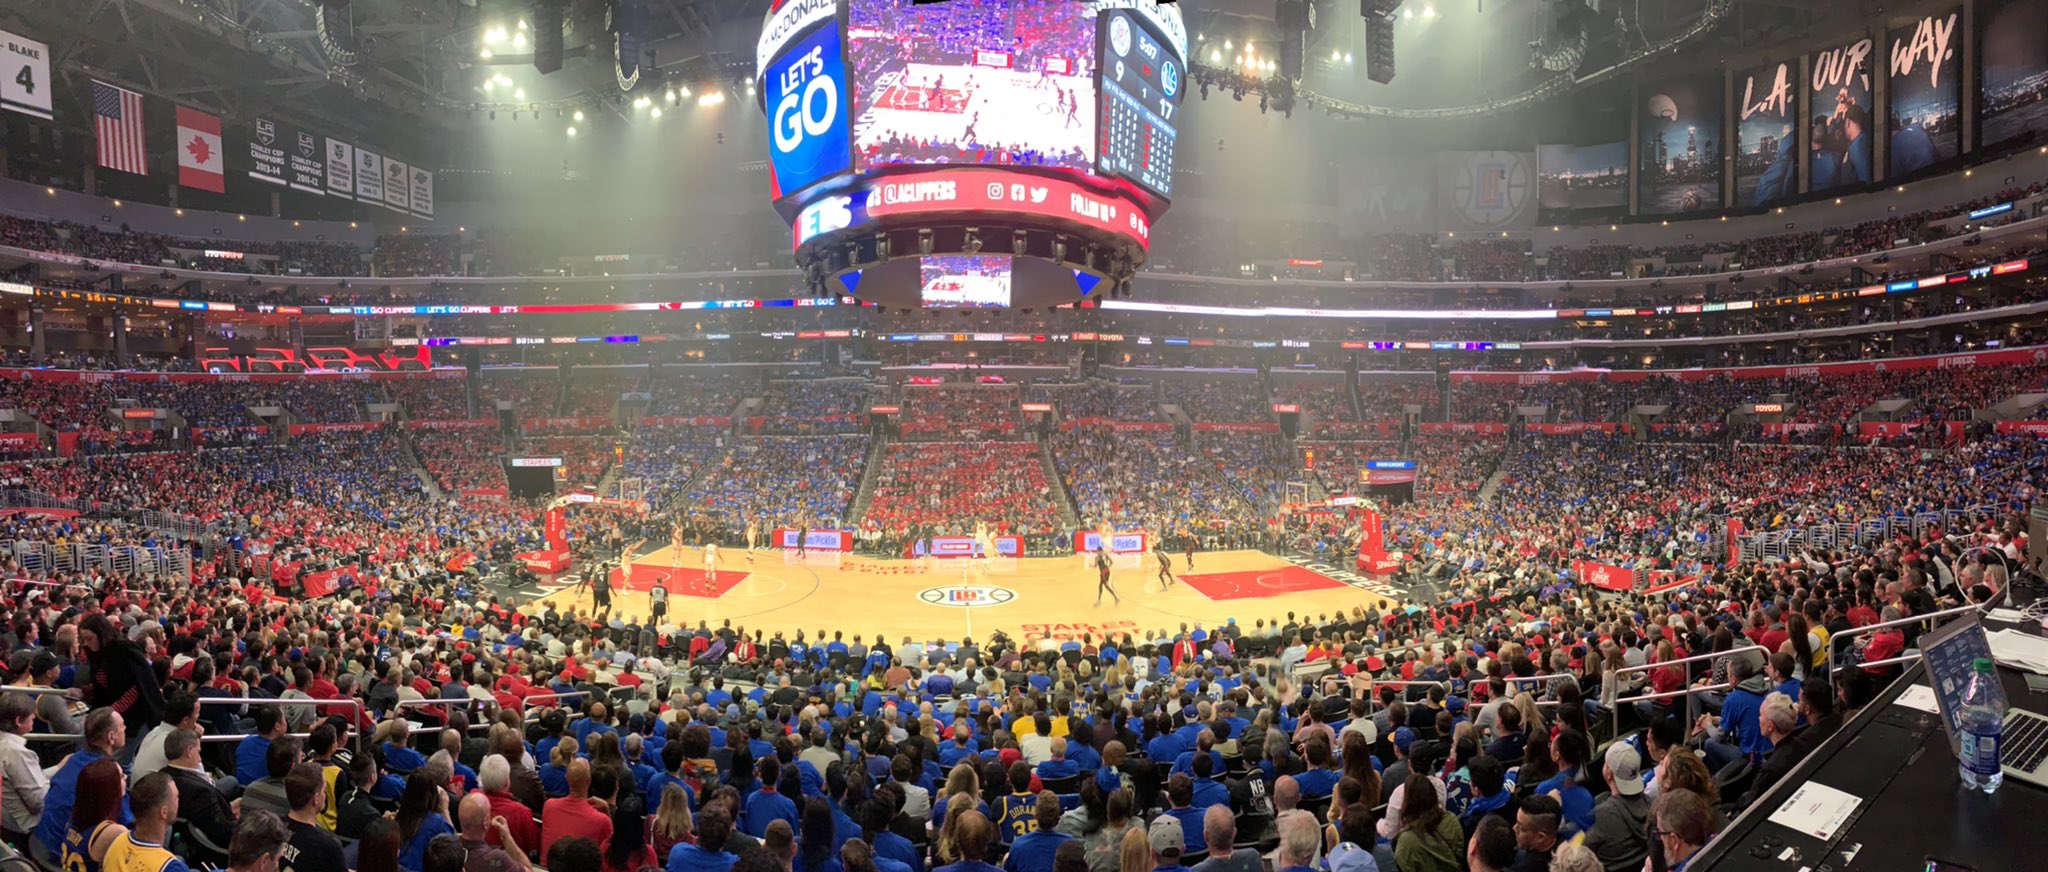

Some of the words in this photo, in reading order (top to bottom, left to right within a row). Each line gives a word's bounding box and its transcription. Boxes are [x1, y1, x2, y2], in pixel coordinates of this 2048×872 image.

[8, 41, 40, 60] BLAKE
[1890, 13, 1957, 88] WAY.
[780, 45, 823, 95] LET'S
[1115, 60, 1124, 82] 9
[1812, 38, 1872, 91] OUR
[15, 64, 35, 95] 4
[1741, 63, 1793, 121] L.A.
[774, 74, 838, 153] GO
[1159, 98, 1173, 120] 17
[250, 150, 285, 165] CHAMPIONS
[272, 149, 284, 157] CUP
[256, 161, 280, 175] 2013-14
[291, 162, 322, 177] CHAMPIONS
[312, 161, 322, 169] CUP
[296, 173, 318, 186] 2011-12
[385, 306, 416, 314] CLIPPERS
[427, 306, 446, 314] LET'S
[448, 306, 460, 314] GO
[460, 306, 491, 314] CLIPPERS
[1305, 564, 1408, 596] CLIPPERS
[1249, 779, 1265, 798] NB
